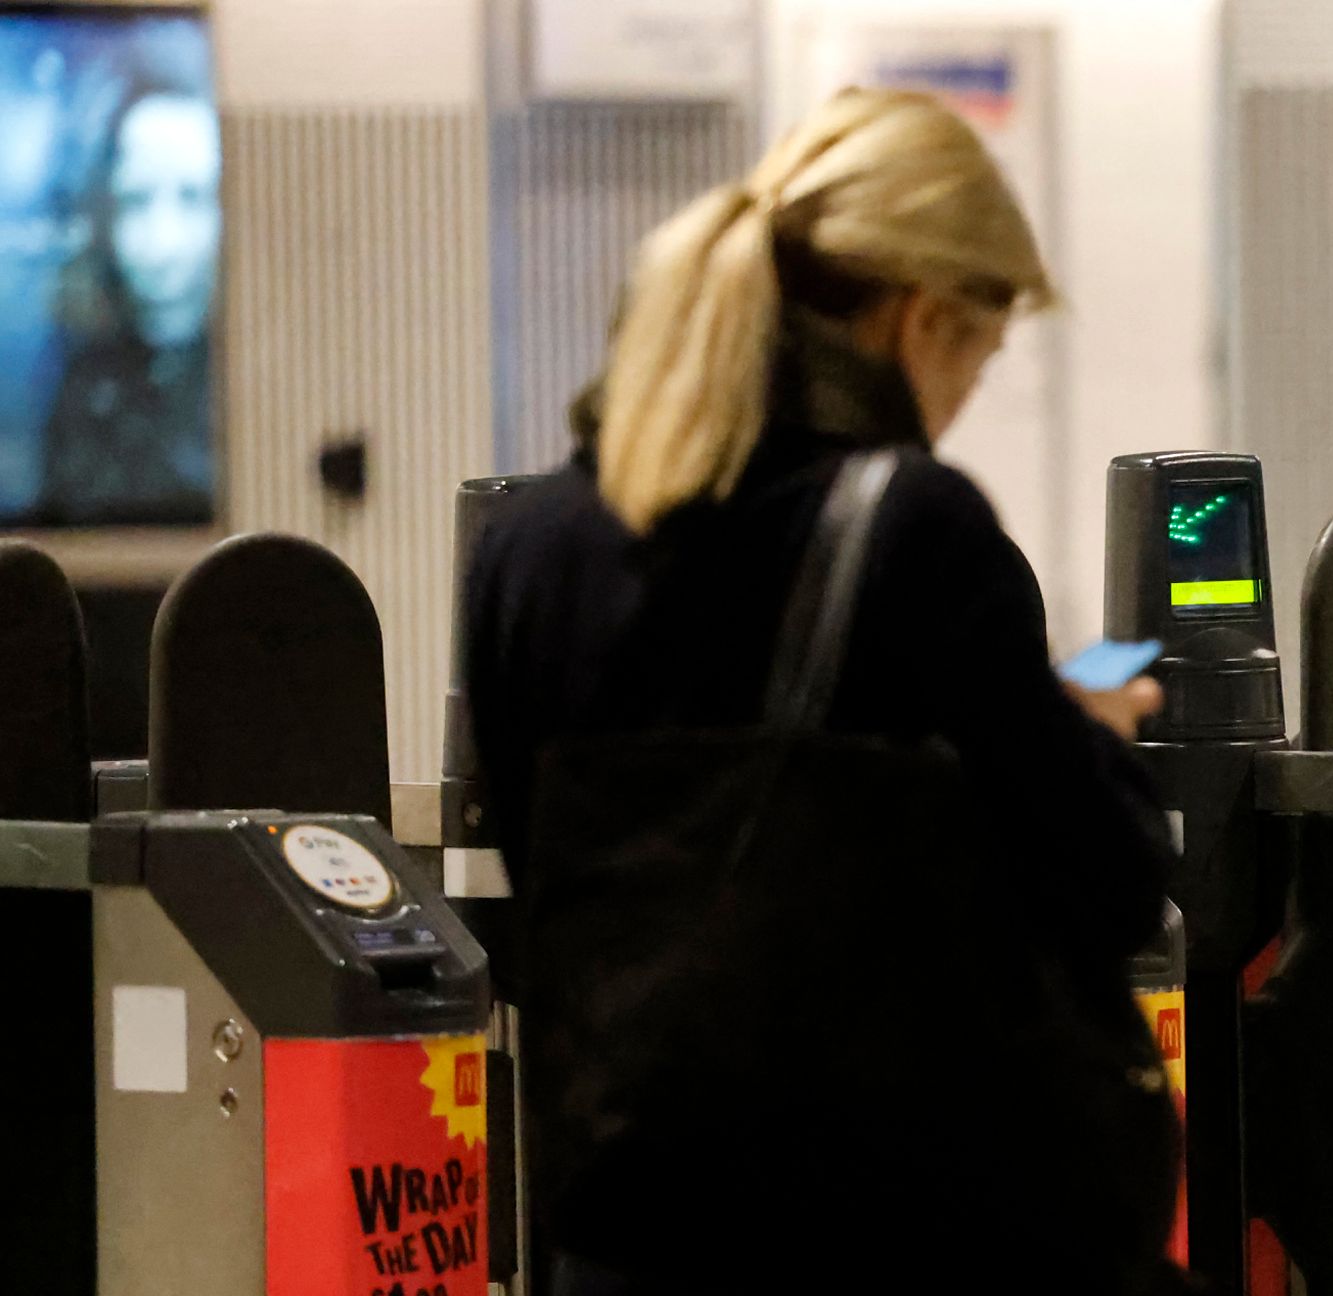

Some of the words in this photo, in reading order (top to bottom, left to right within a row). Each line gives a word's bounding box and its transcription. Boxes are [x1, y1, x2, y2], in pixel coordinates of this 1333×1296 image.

[349, 1157, 462, 1235] WRAP
[364, 1233, 421, 1277] THE
[421, 1211, 478, 1276] DAY
